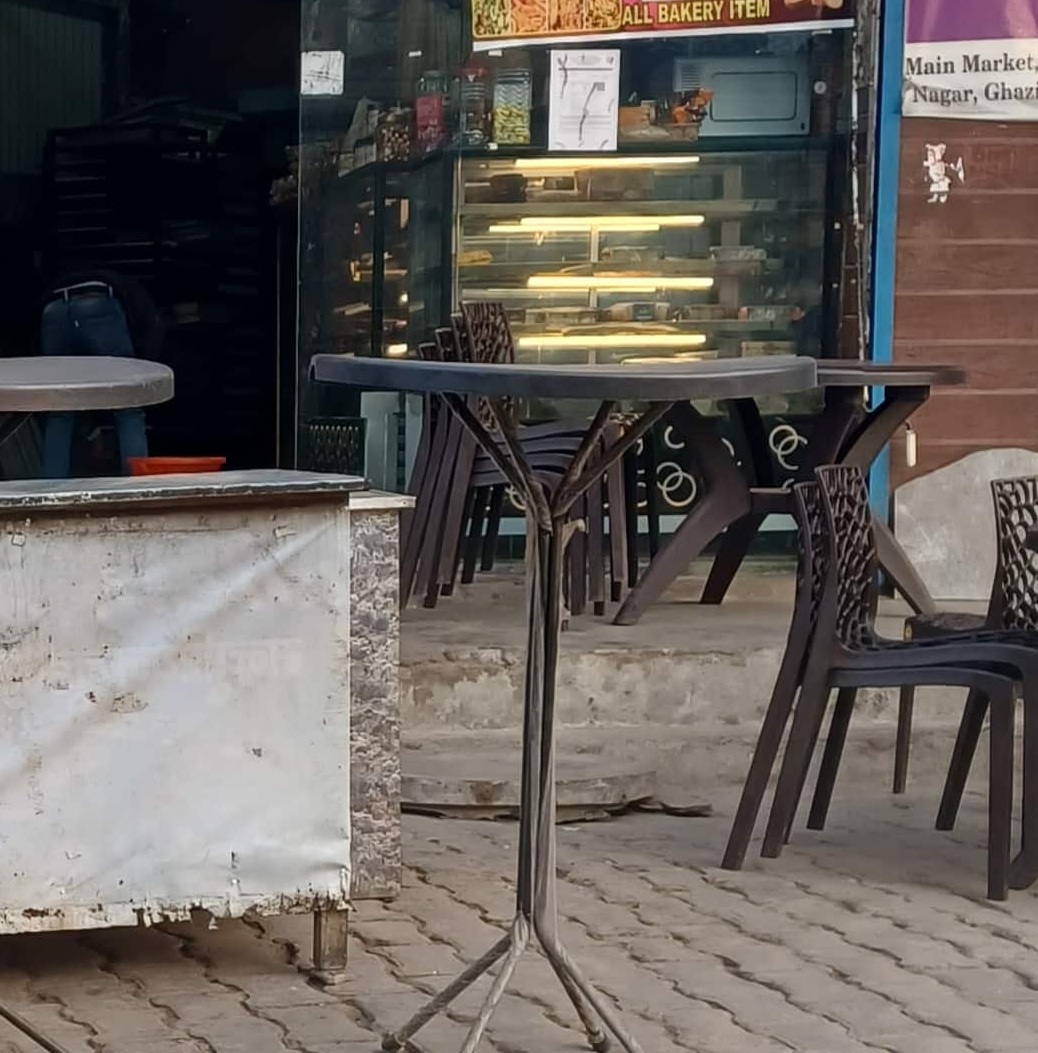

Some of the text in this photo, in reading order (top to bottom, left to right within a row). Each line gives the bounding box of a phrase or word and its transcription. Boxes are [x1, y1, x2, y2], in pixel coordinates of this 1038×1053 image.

[622, 4, 653, 25] ALL
[658, 0, 724, 23] BAKERY
[906, 55, 955, 76] Main
[913, 85, 978, 107] Nagar,
